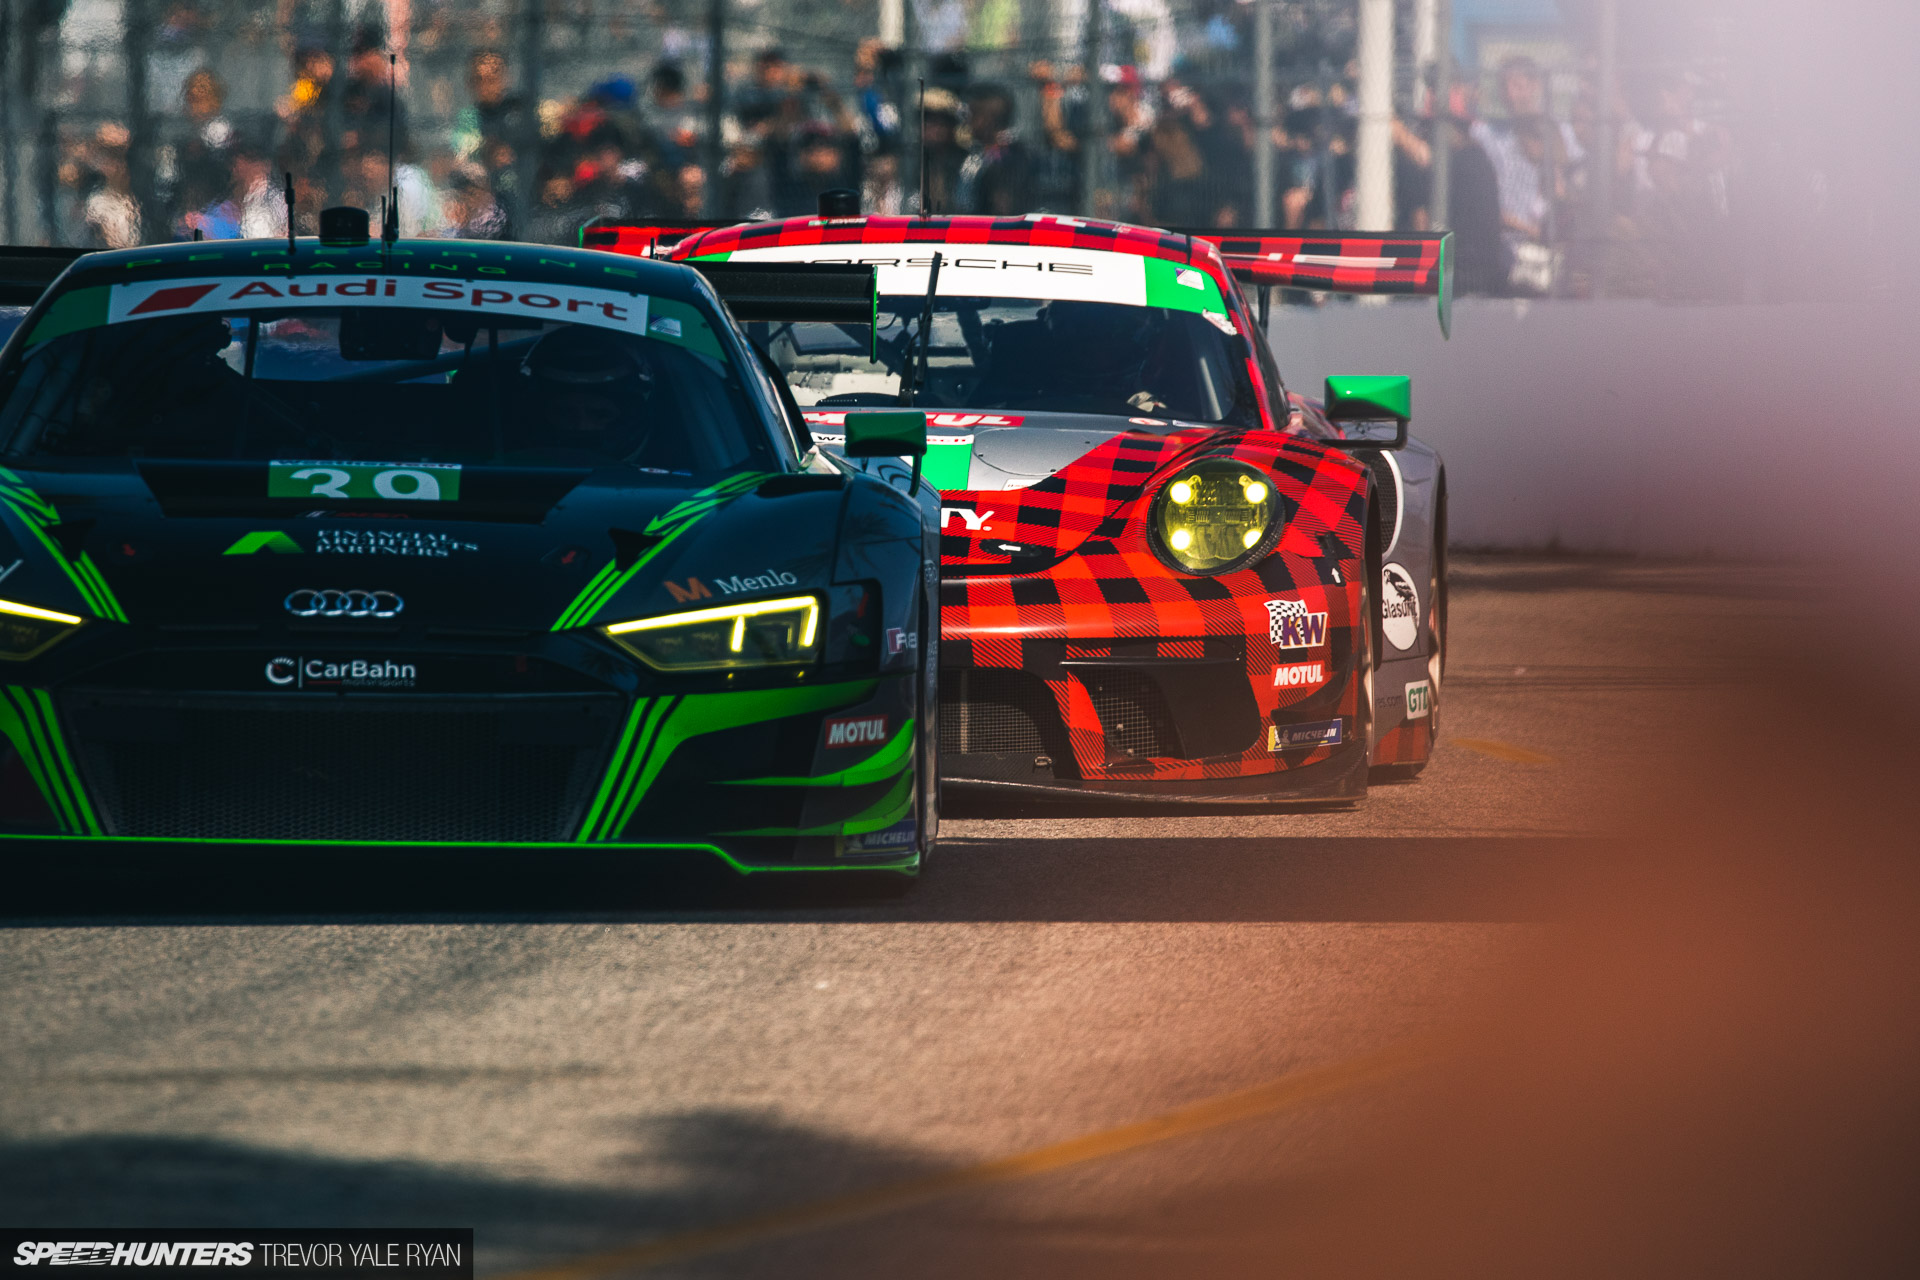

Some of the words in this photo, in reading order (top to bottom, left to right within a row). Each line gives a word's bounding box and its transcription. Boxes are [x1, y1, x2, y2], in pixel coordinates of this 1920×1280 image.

[263, 261, 506, 275] RACING
[229, 278, 397, 300] Audi
[422, 281, 628, 321] Sport
[713, 569, 797, 594] Menlo
[1282, 613, 1326, 647] KW
[305, 659, 416, 679] CarBahn
[1274, 664, 1323, 686] MOTUL
[828, 719, 885, 746] MOTUL
[1291, 727, 1338, 742] MICHELIN
